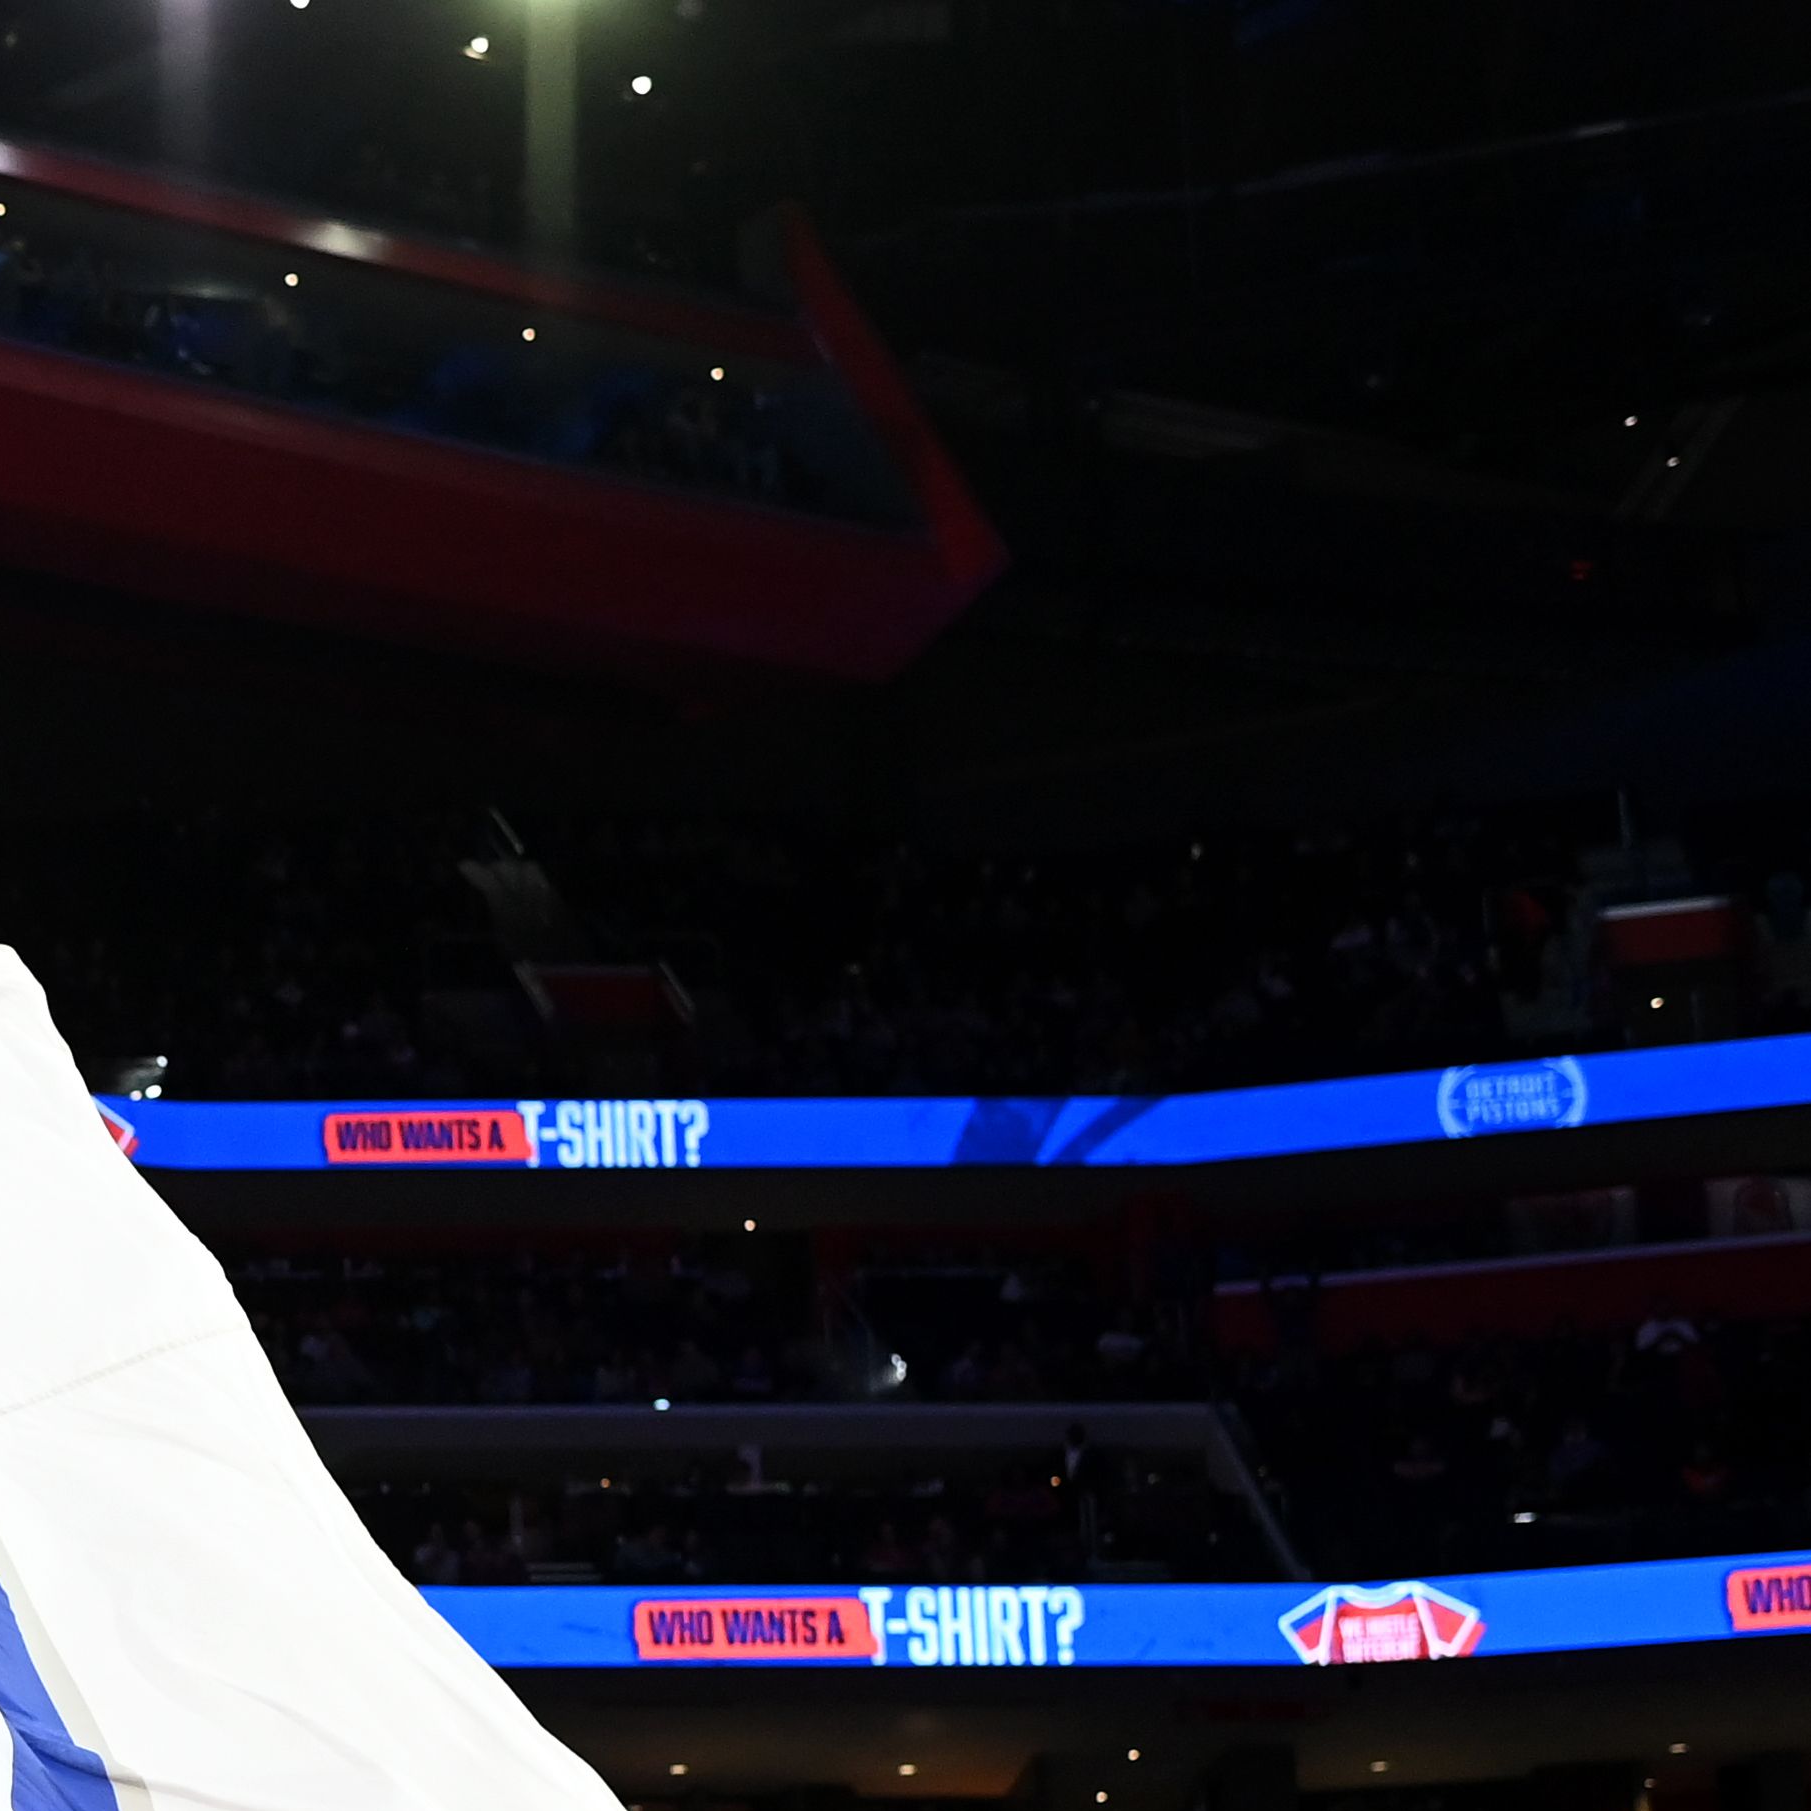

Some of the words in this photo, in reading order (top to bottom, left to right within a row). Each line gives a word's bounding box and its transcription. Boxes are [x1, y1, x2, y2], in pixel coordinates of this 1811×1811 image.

[336, 1120, 391, 1152] WHO
[399, 1119, 480, 1151] WANTS
[488, 1119, 505, 1151] A
[516, 1100, 709, 1168] T-SHIRT?
[648, 1609, 714, 1645] WHO
[722, 1609, 816, 1645] WANTS
[826, 1609, 845, 1645] A
[858, 1587, 1084, 1666] T-SHIRT?
